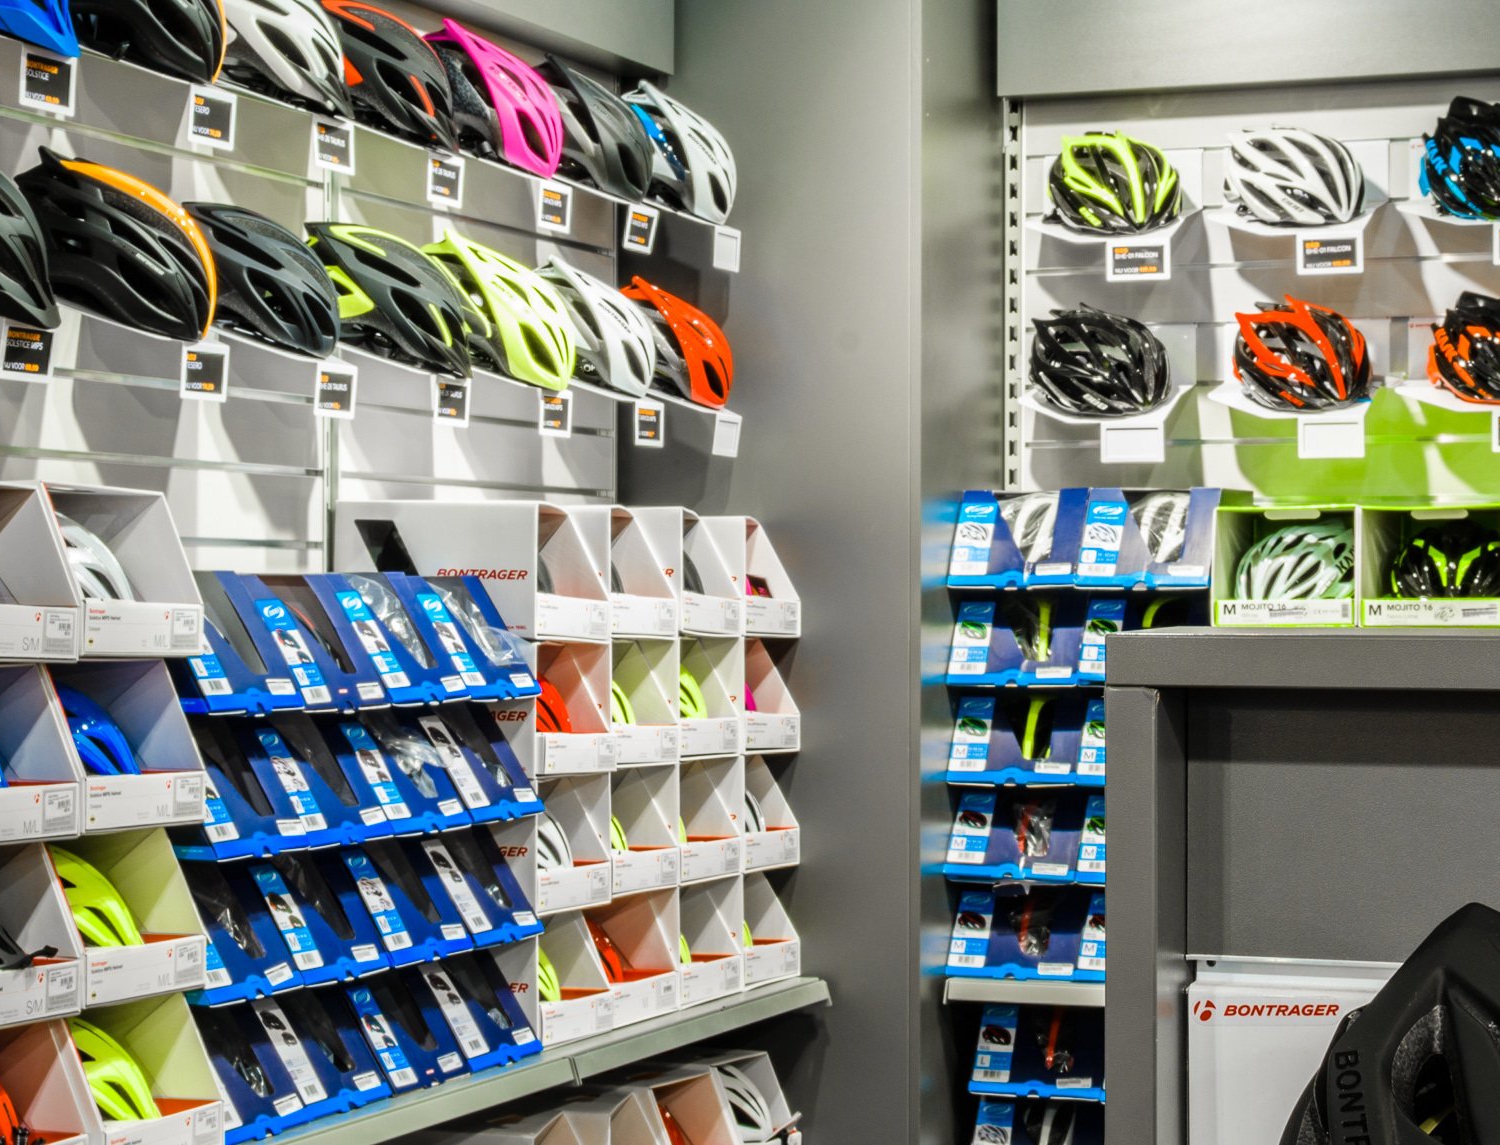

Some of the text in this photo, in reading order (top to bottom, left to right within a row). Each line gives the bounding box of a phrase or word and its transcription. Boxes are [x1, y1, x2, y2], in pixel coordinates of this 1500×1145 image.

[437, 569, 528, 580] BONTRAGER
[1223, 604, 1236, 615] M
[1241, 603, 1274, 611] MOJITO
[1368, 603, 1434, 616] M MOJITO 16
[22, 637, 40, 651] S/M
[154, 634, 168, 647] M/L
[156, 805, 170, 817] M/L
[23, 821, 39, 834] M/L
[26, 999, 43, 1015] S/M
[1224, 1004, 1340, 1017] BONTRAGER
